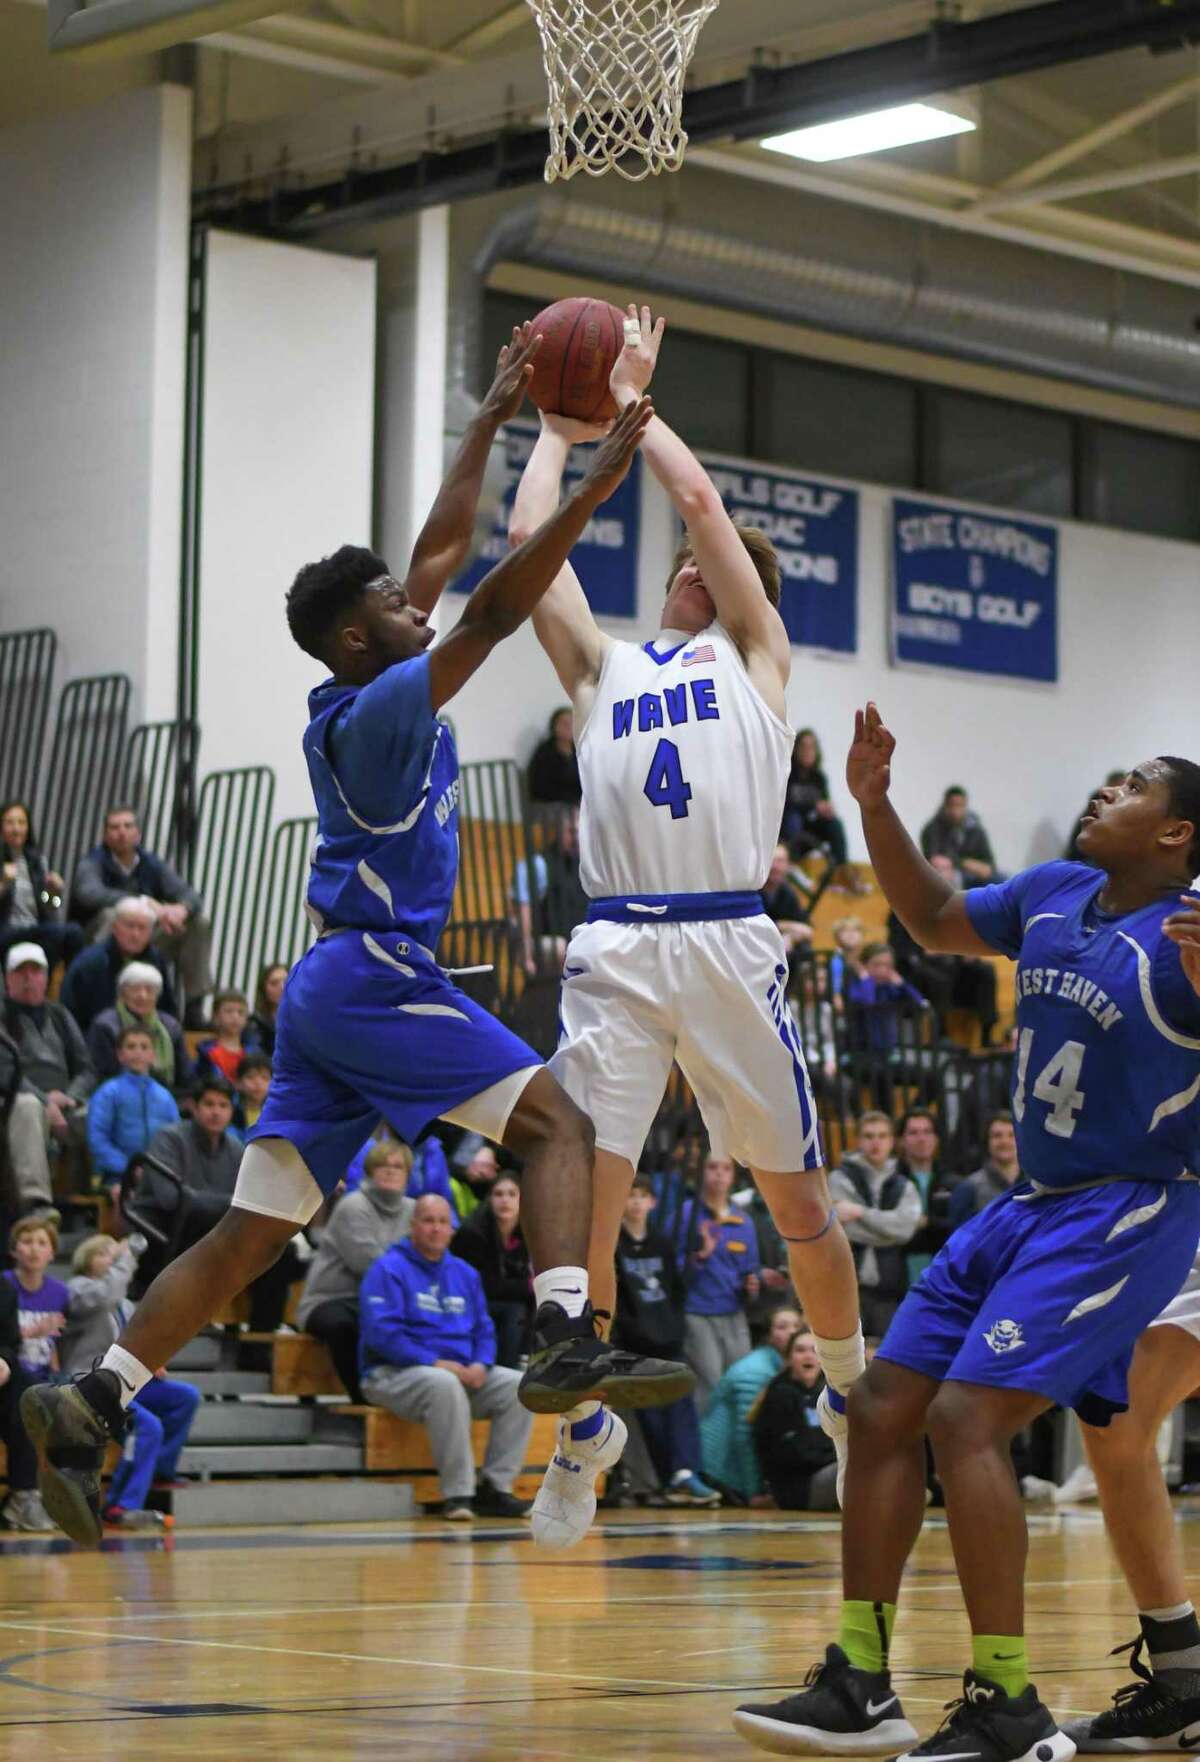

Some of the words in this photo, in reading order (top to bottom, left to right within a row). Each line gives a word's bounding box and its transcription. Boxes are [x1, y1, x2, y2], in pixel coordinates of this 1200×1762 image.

[774, 482, 843, 517] GOLF
[908, 581, 973, 621] BOYS
[976, 593, 1041, 630] GOLF
[612, 678, 721, 741] WAVE
[643, 737, 692, 820] 4
[1056, 970, 1124, 1032] HAVEN
[1012, 1025, 1087, 1139] 14
